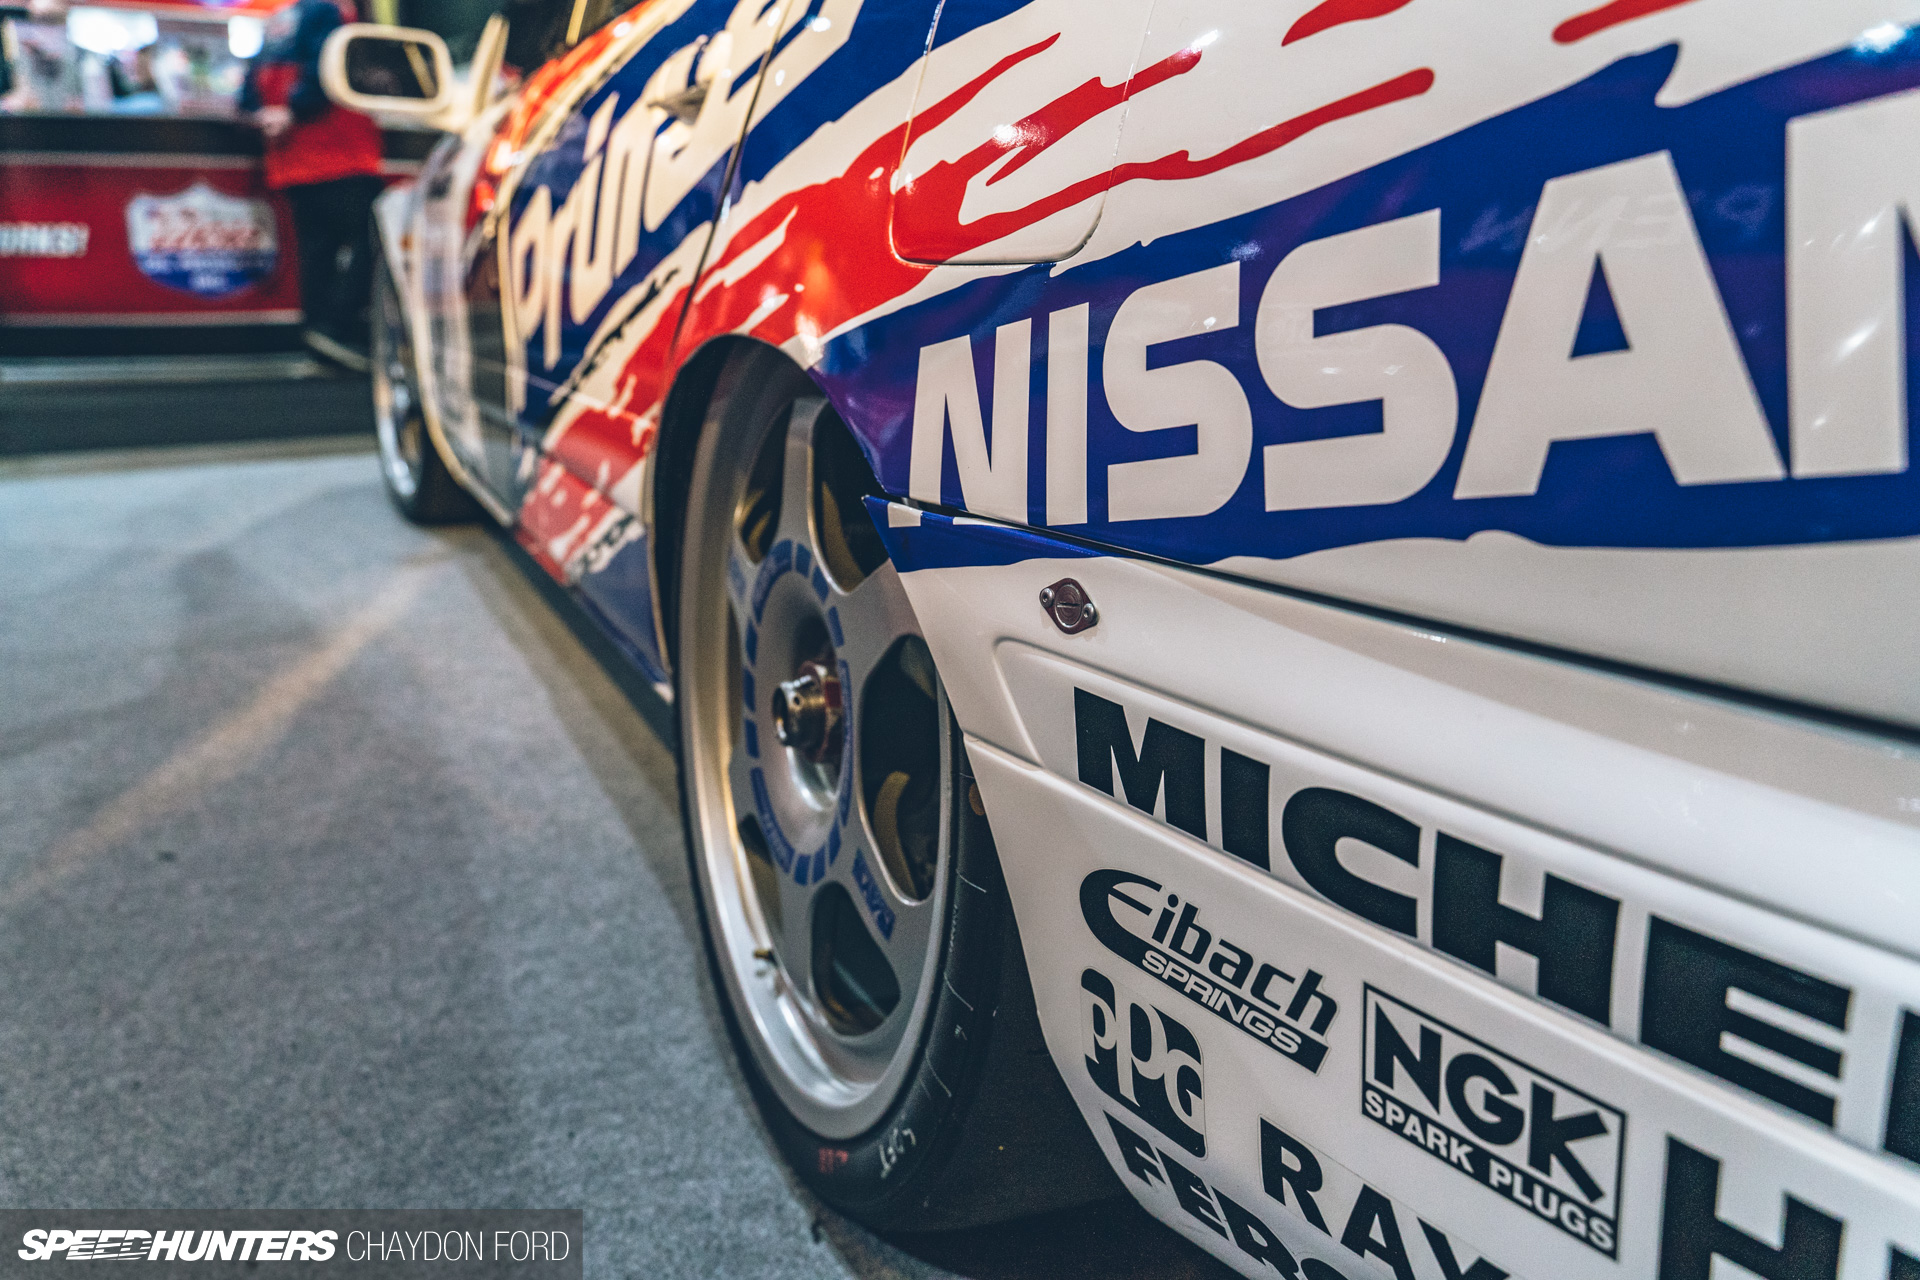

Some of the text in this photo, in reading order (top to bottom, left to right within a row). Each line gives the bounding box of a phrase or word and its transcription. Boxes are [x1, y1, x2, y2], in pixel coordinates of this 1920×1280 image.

[1074, 687, 1920, 1167] MICHE
[1080, 869, 1337, 1037] Eibach
[1142, 950, 1302, 1055] SPRINGS
[1081, 968, 1206, 1158] PPG
[1374, 1001, 1609, 1203] NGK
[1102, 1109, 1351, 1280] FER
[1365, 1089, 1615, 1251] SPARK PLUGS
